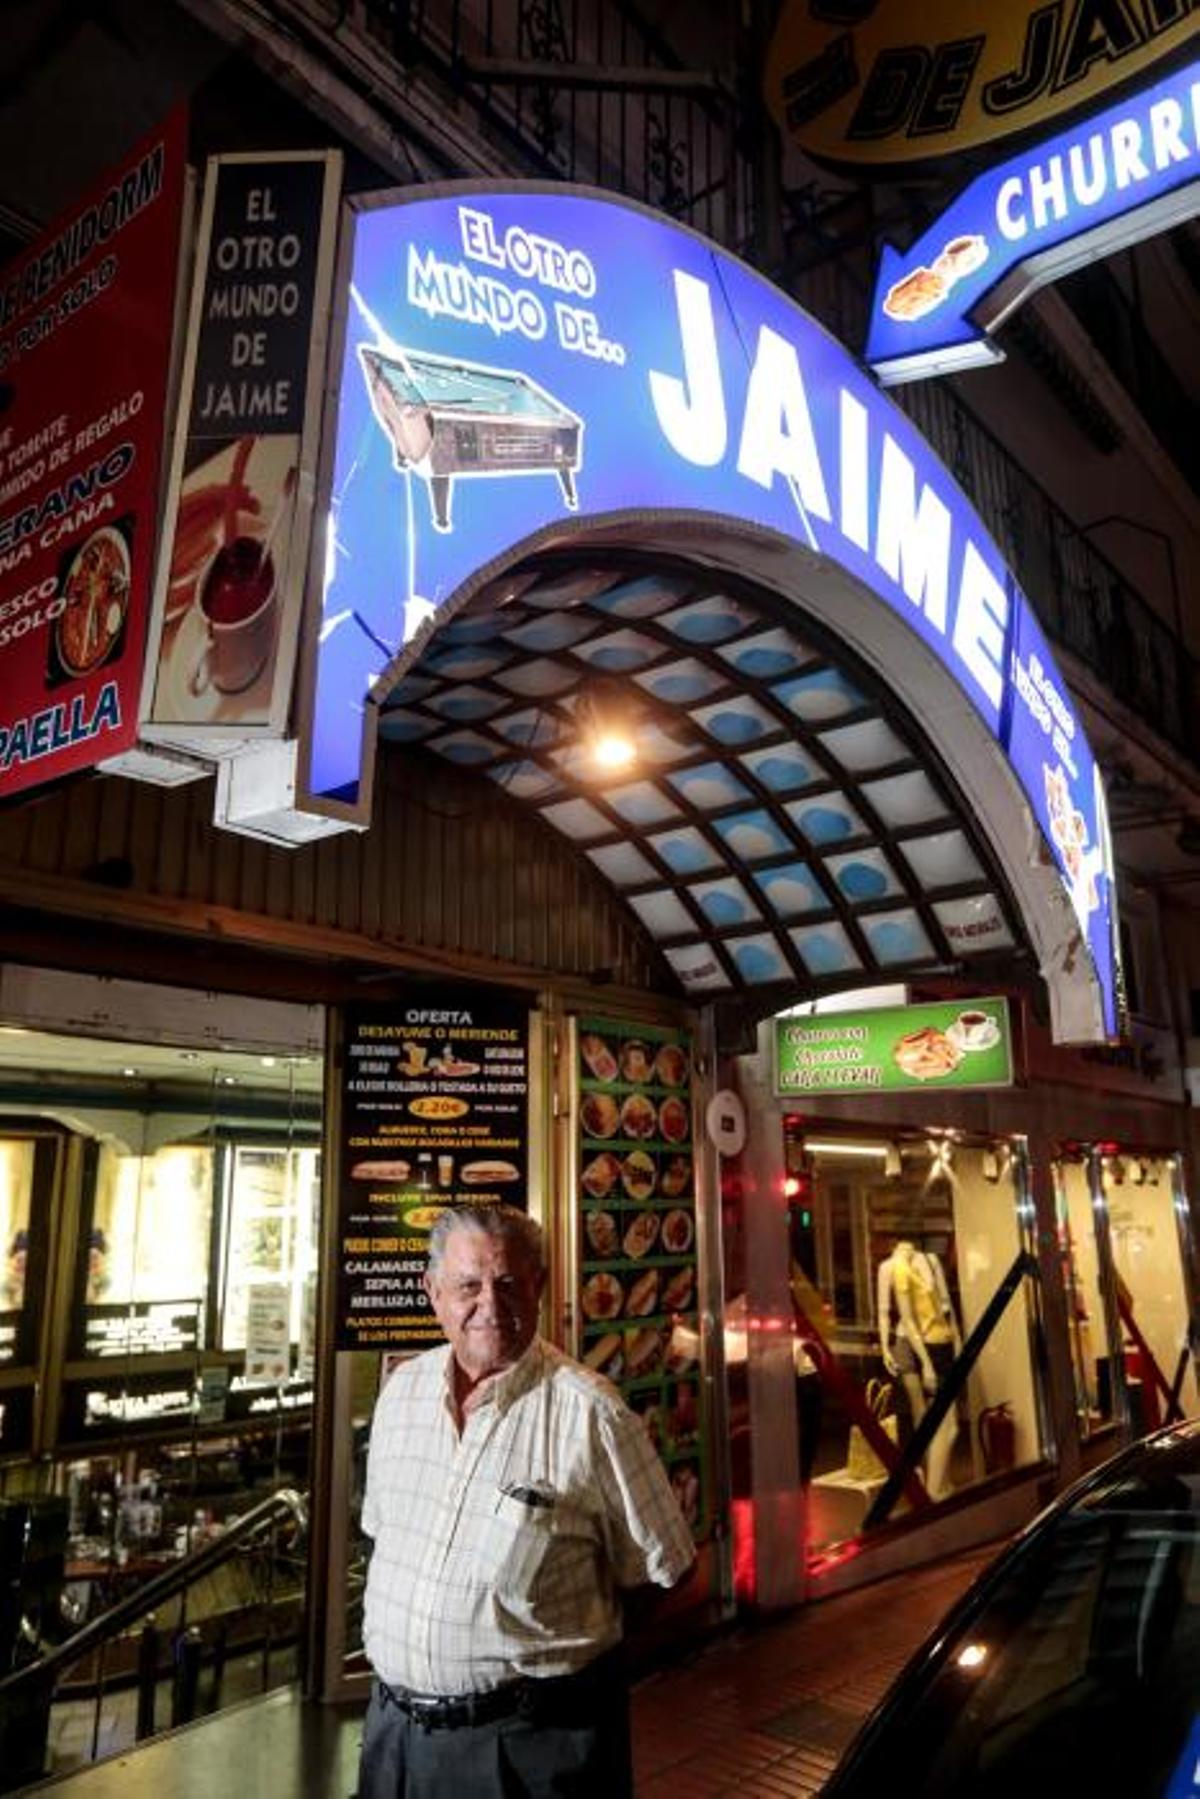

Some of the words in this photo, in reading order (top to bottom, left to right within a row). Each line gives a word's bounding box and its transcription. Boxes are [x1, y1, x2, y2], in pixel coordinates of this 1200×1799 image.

[847, 34, 986, 140] DE
[982, 0, 1200, 116] JA
[996, 84, 1200, 241] CHURR
[246, 189, 276, 221] EL
[216, 235, 300, 270] OTRO
[458, 206, 506, 269] EL
[505, 226, 596, 298] OTRO
[209, 284, 299, 318] MUNDO
[407, 242, 547, 341] MUNDO
[231, 332, 267, 366] DE
[201, 381, 290, 419] JAIME
[74, 390, 144, 455] REGALO
[648, 268, 1009, 714] JAIME
[405, 1008, 473, 1025] OFERTA
[345, 1260, 425, 1274] CALAMARES
[404, 1279, 415, 1290] A
[350, 1295, 414, 1308] MERLUZA
